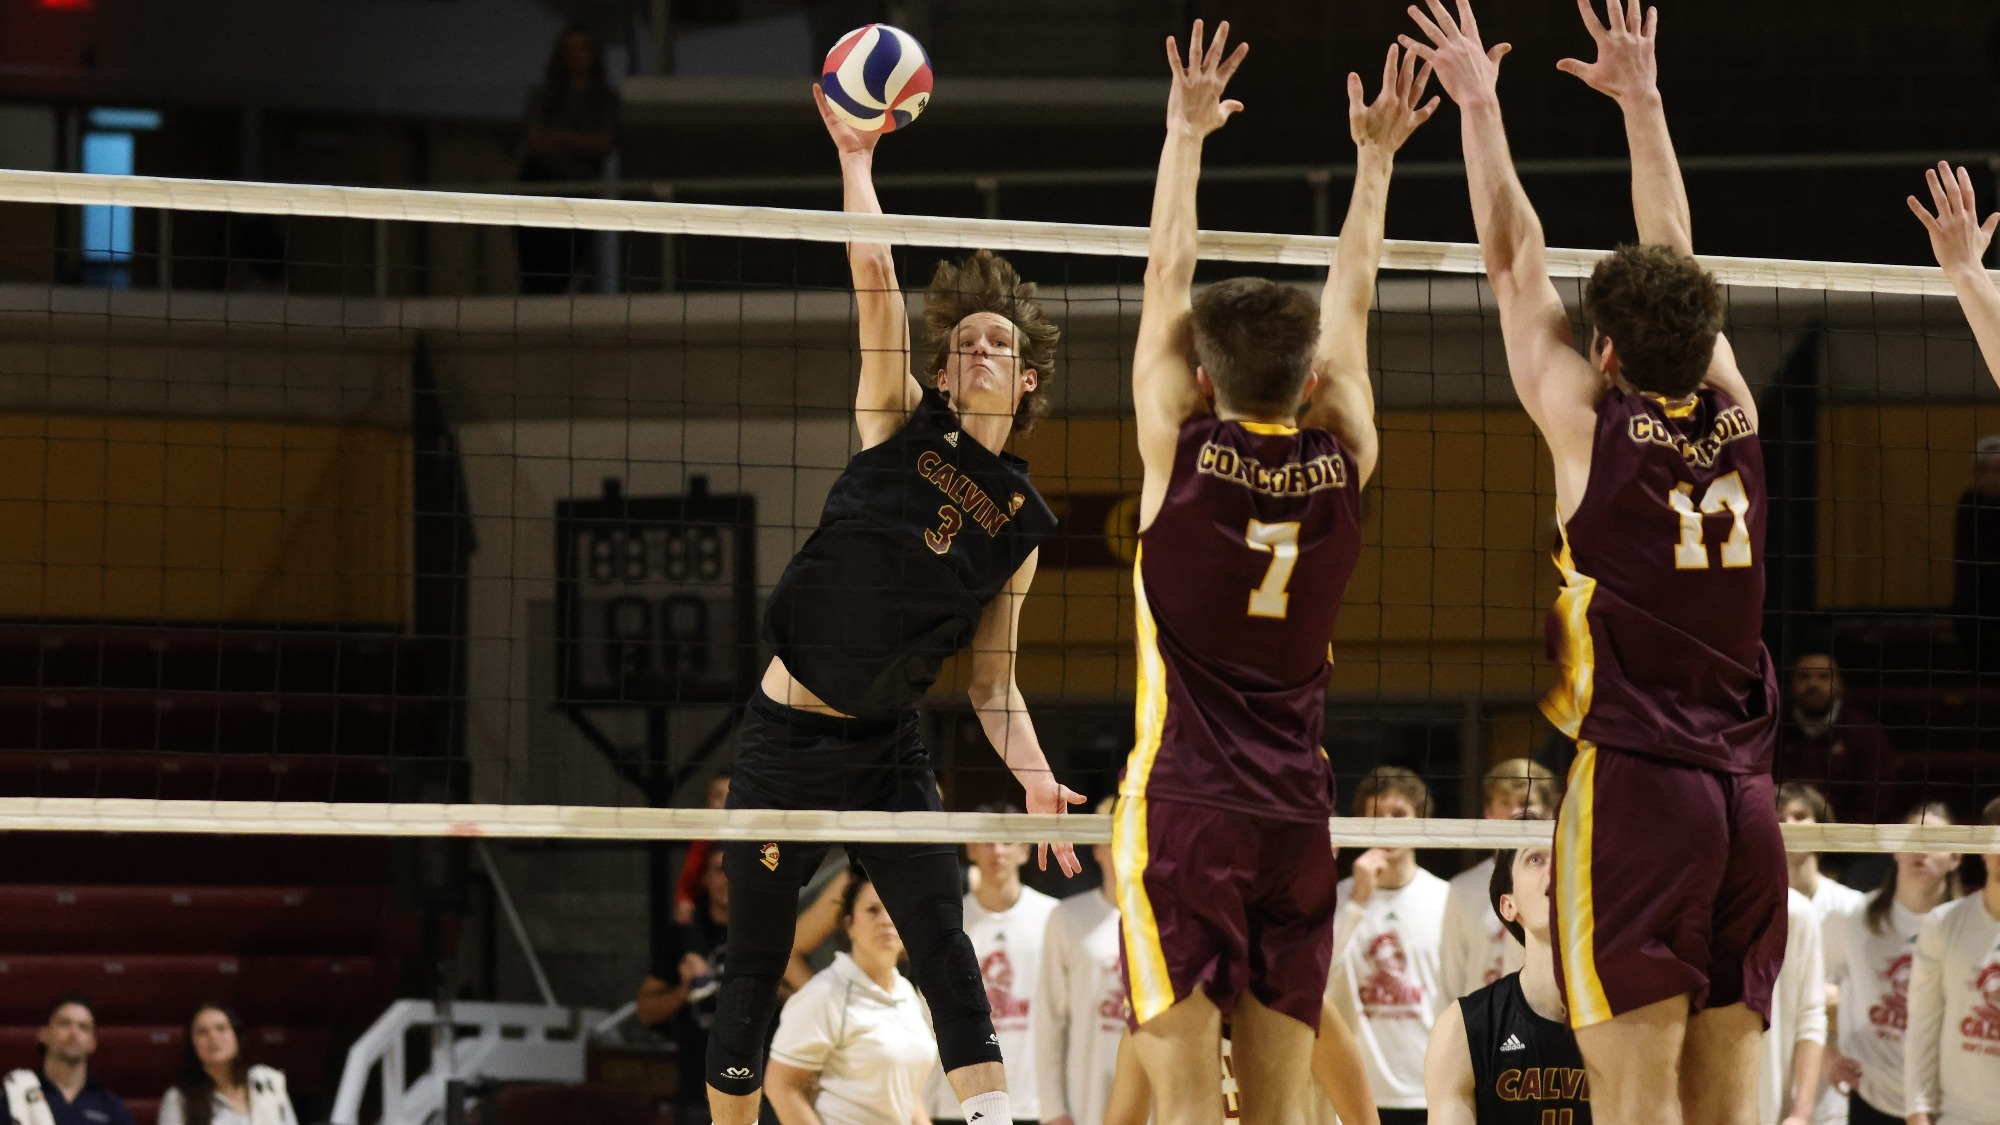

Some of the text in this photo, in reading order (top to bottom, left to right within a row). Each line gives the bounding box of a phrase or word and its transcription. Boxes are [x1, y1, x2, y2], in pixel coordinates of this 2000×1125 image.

[1628, 405, 1753, 467] COCRDIA
[917, 451, 1010, 538] CALVIN
[924, 504, 963, 555] 3
[1668, 470, 1752, 570] 17
[1245, 517, 1301, 619] 7
